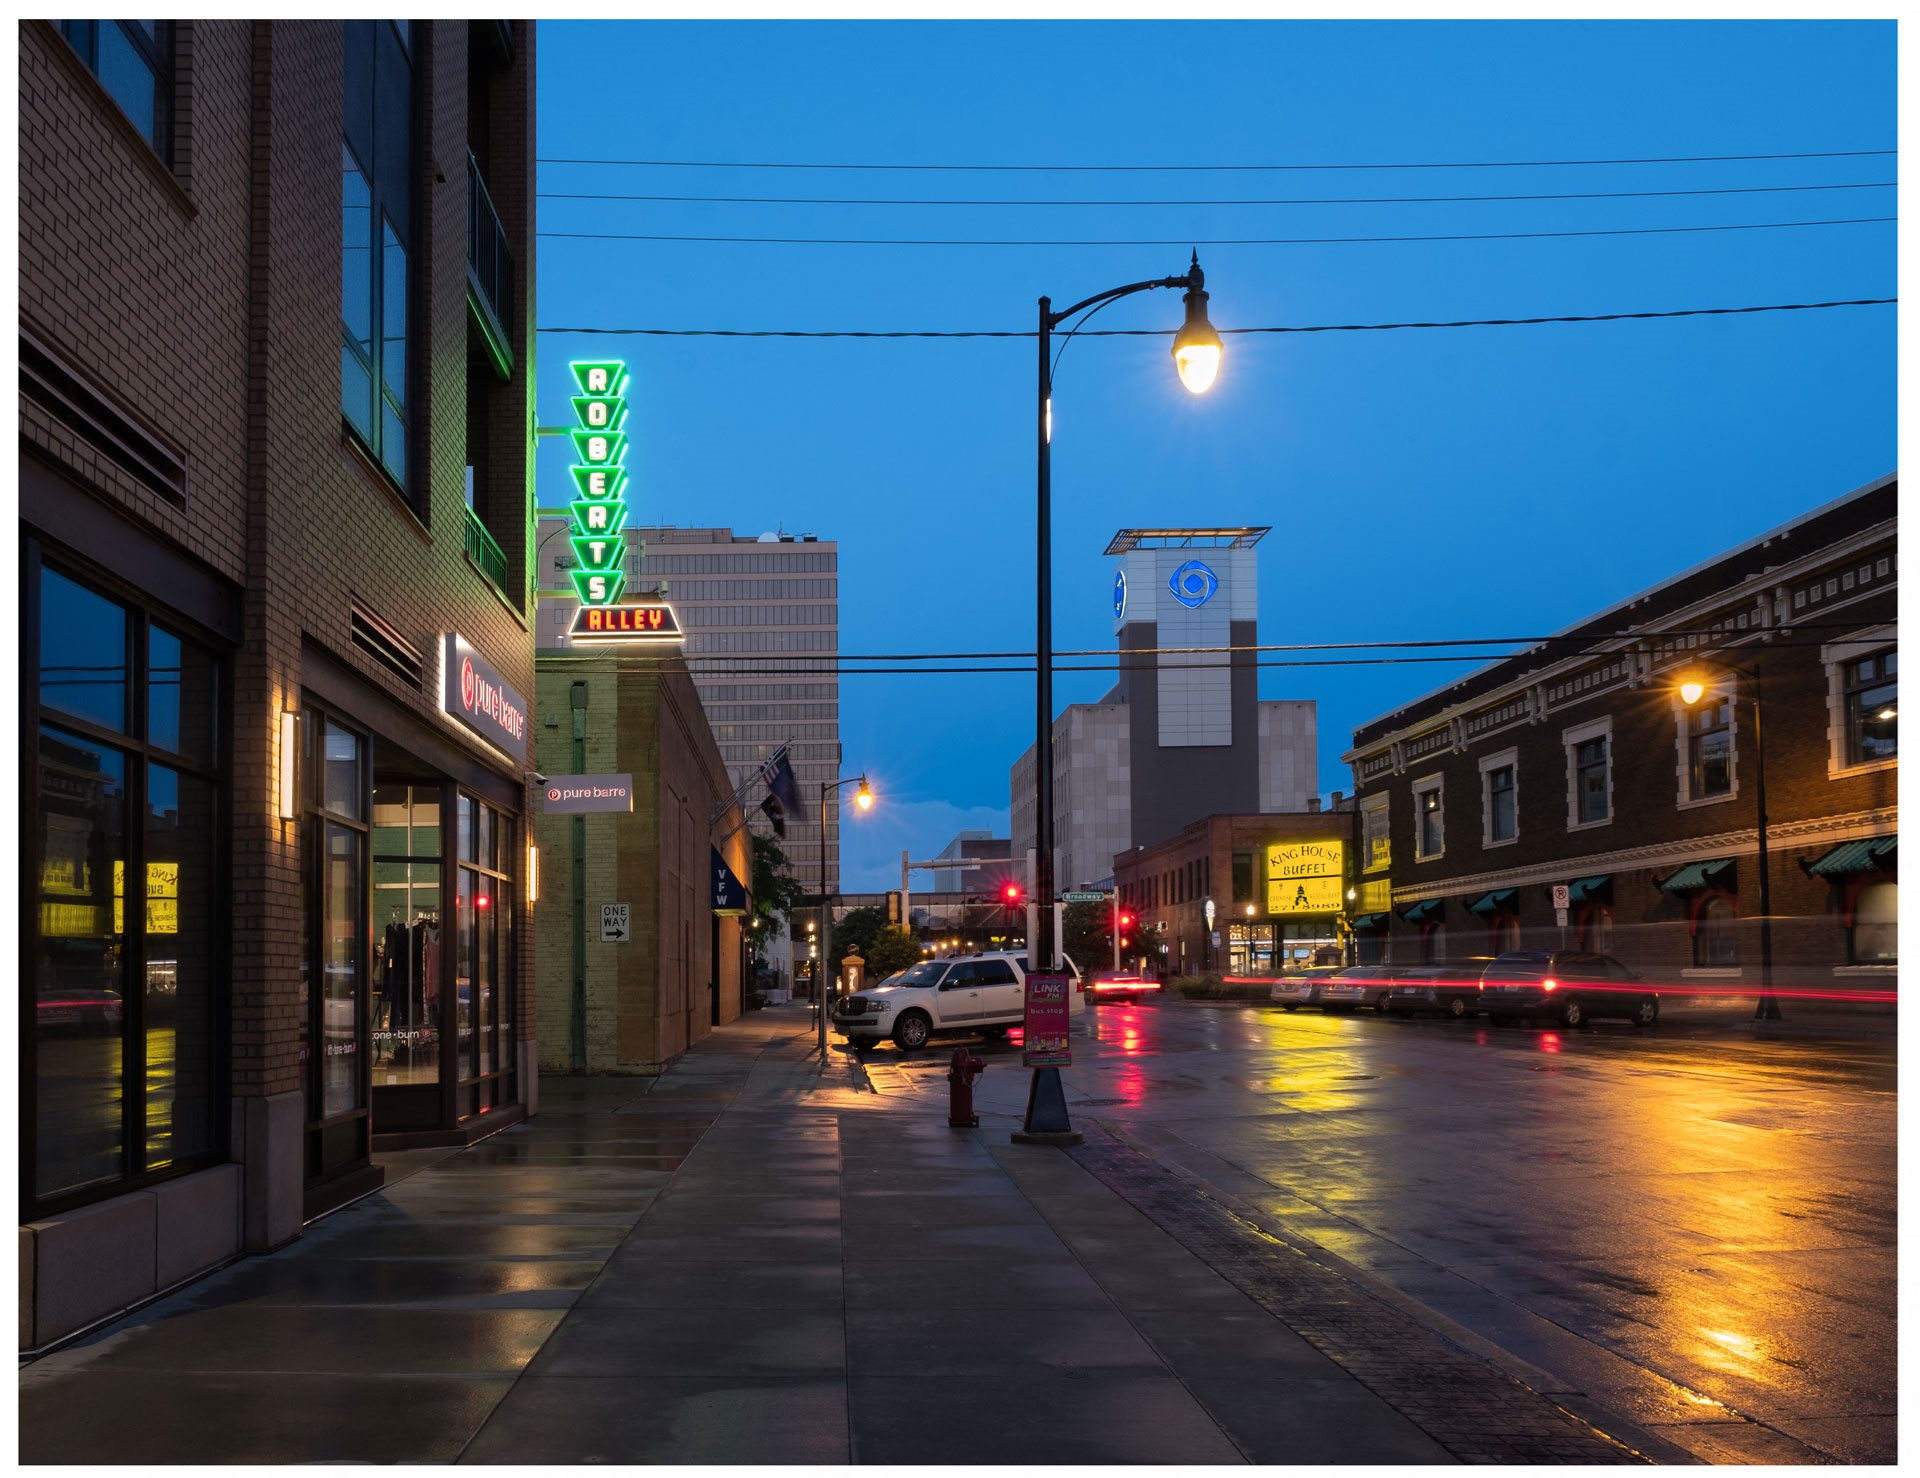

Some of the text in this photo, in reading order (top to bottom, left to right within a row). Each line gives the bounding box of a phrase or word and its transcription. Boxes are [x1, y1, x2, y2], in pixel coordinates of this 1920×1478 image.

[588, 367, 607, 600] ROBERTS
[589, 609, 662, 631] ALLEY
[475, 673, 498, 720] pure
[499, 685, 524, 740] barre
[563, 788, 592, 800] pure
[593, 786, 626, 798] barre
[1270, 845, 1341, 867] KING HOUSE
[1283, 863, 1326, 876] BUFFET
[716, 869, 728, 905] VFW
[1065, 893, 1101, 901] Broadway
[603, 906, 627, 916] ONE
[603, 917, 627, 928] WAY
[1034, 984, 1061, 993] LINK
